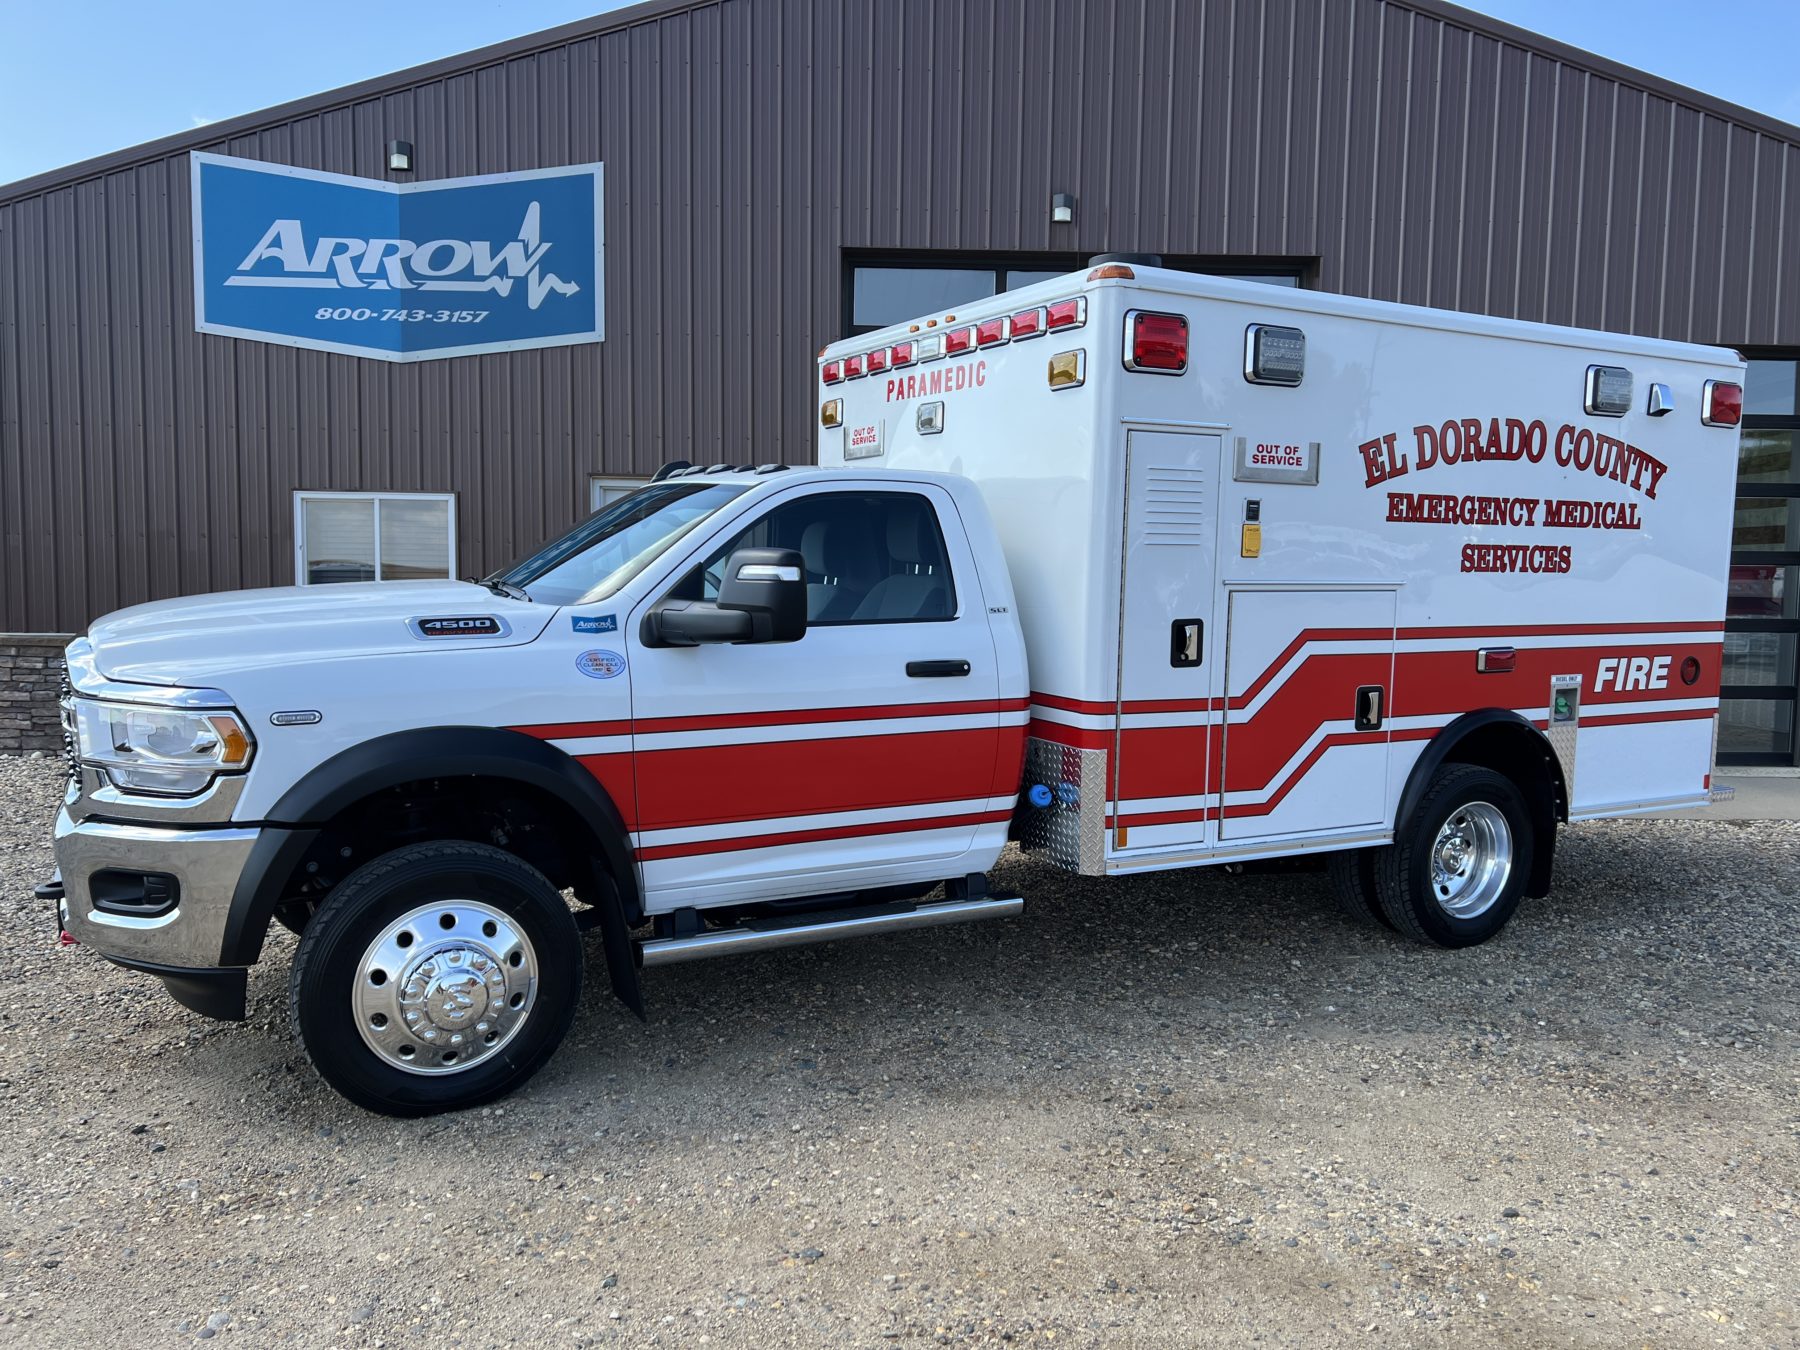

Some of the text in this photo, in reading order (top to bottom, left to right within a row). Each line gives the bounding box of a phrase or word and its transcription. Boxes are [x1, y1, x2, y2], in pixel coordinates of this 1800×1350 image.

[237, 217, 552, 290] ARROW
[315, 306, 489, 324] 800-743-3157
[886, 360, 987, 402] PARAMEDIC
[852, 434, 877, 446] SERVICE
[853, 426, 875, 437] OUT OF
[1252, 454, 1302, 466] SERVICE
[1256, 444, 1300, 455] OUT OF
[1359, 418, 1668, 500] EL DORADO COUNTY
[1386, 492, 1641, 530] EMERGENCY MEDICAL
[1461, 545, 1572, 574] SERVICES
[425, 619, 491, 629] 4500
[1593, 655, 1672, 694] FIRE
